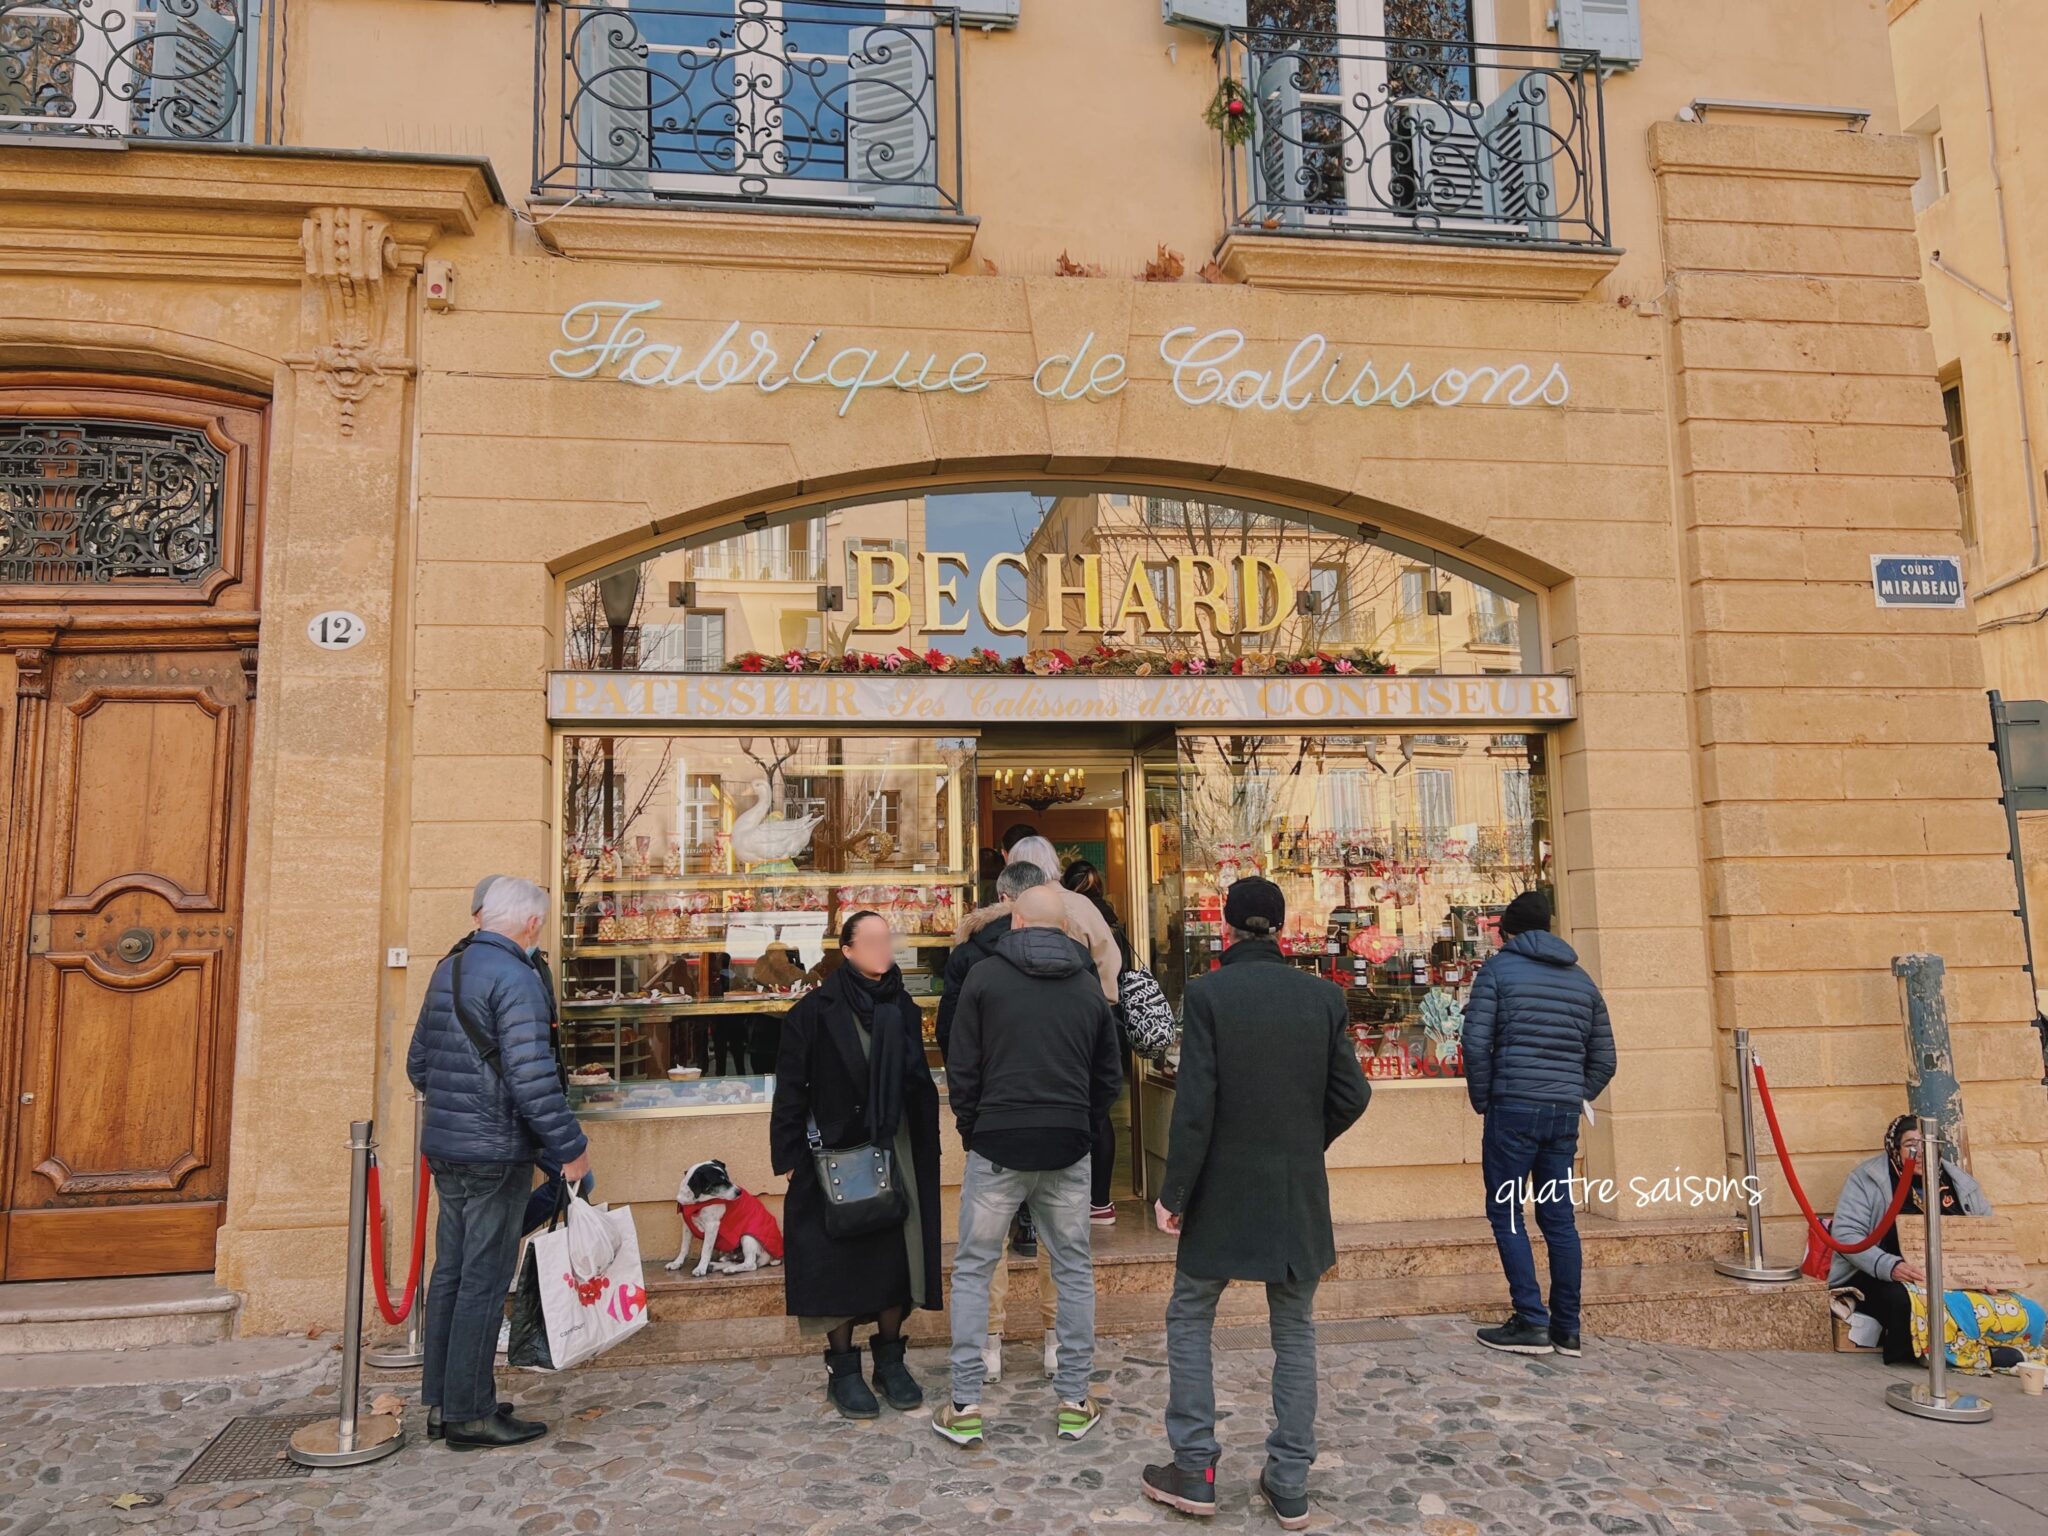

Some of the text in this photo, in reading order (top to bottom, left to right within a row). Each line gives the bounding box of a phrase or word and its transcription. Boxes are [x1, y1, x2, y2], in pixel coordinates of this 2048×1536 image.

[548, 299, 1569, 417] Fabrique de Calissons
[1900, 564, 1935, 576] COURS
[851, 550, 1298, 638] BECHARD
[1881, 580, 1958, 596] MIRABEAU
[319, 616, 352, 644] 12
[558, 676, 863, 717] PATISSIER
[965, 678, 1119, 718] Calissons
[1138, 680, 1230, 718] d'Aix
[1256, 678, 1563, 717] CONFISEUR
